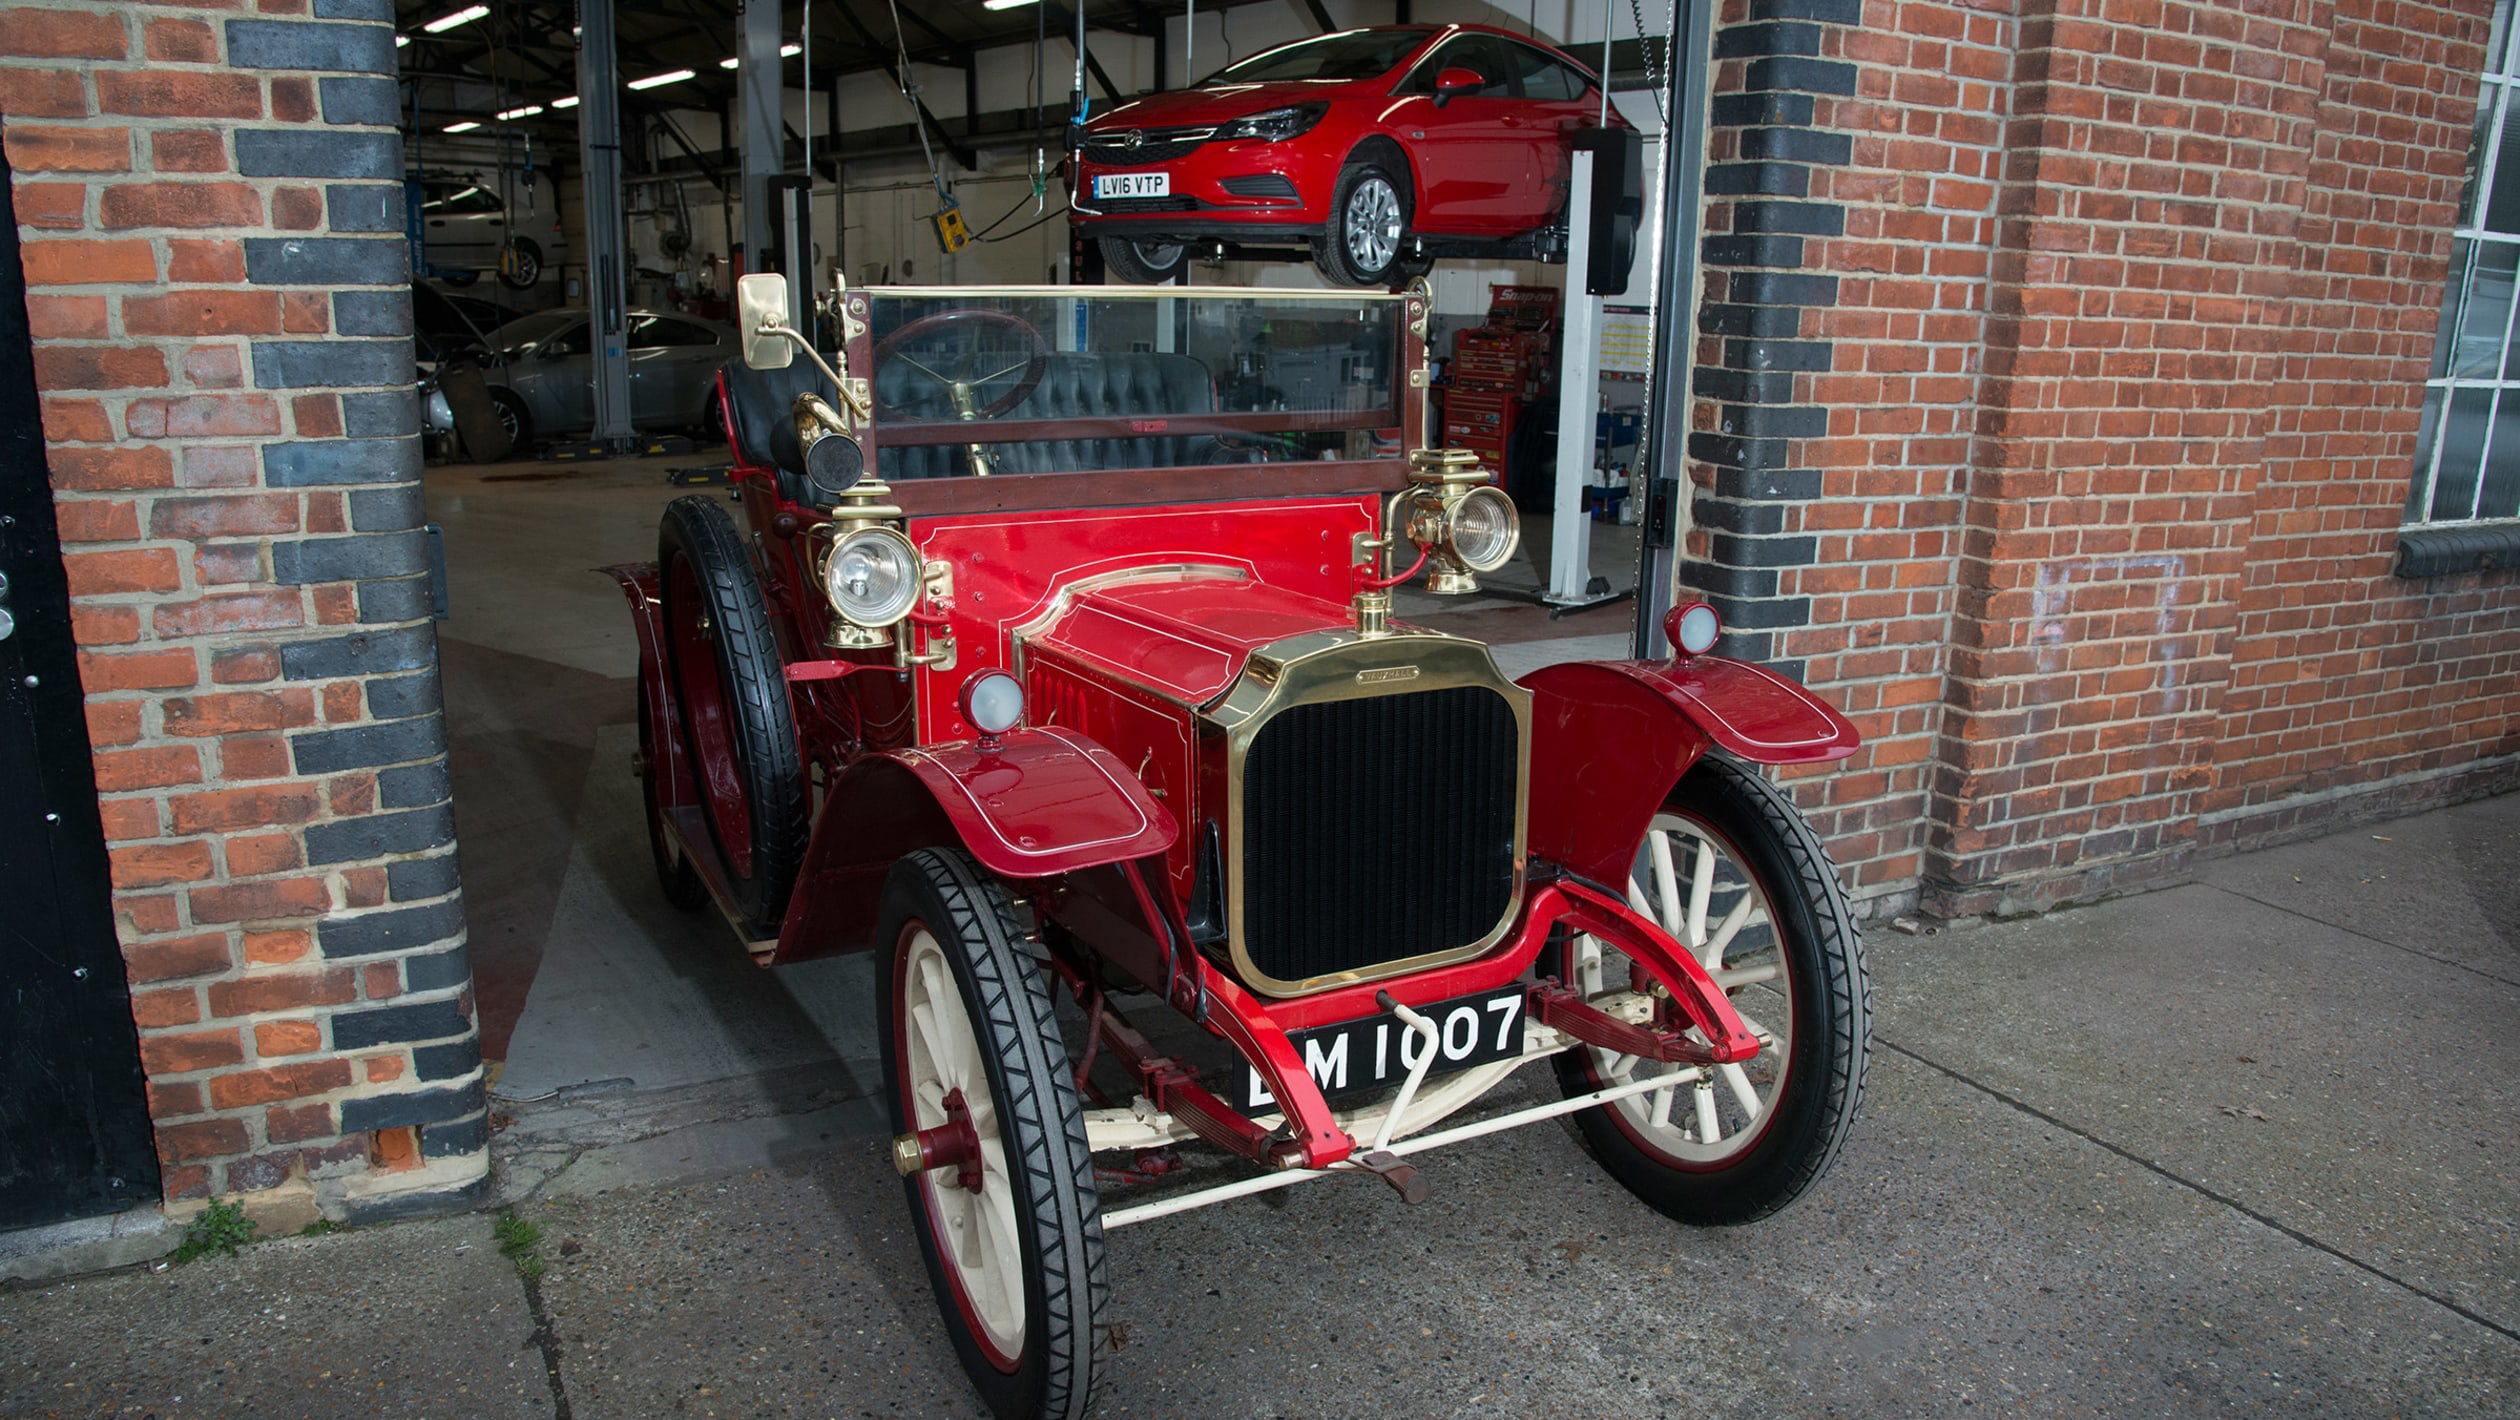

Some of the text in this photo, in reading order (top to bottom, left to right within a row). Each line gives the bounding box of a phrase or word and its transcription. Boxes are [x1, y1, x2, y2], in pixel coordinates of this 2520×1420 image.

[1103, 175, 1163, 195] LV16 VTP
[1500, 288, 1553, 304] Snap-on
[1366, 668, 1412, 681] VAUXHALL
